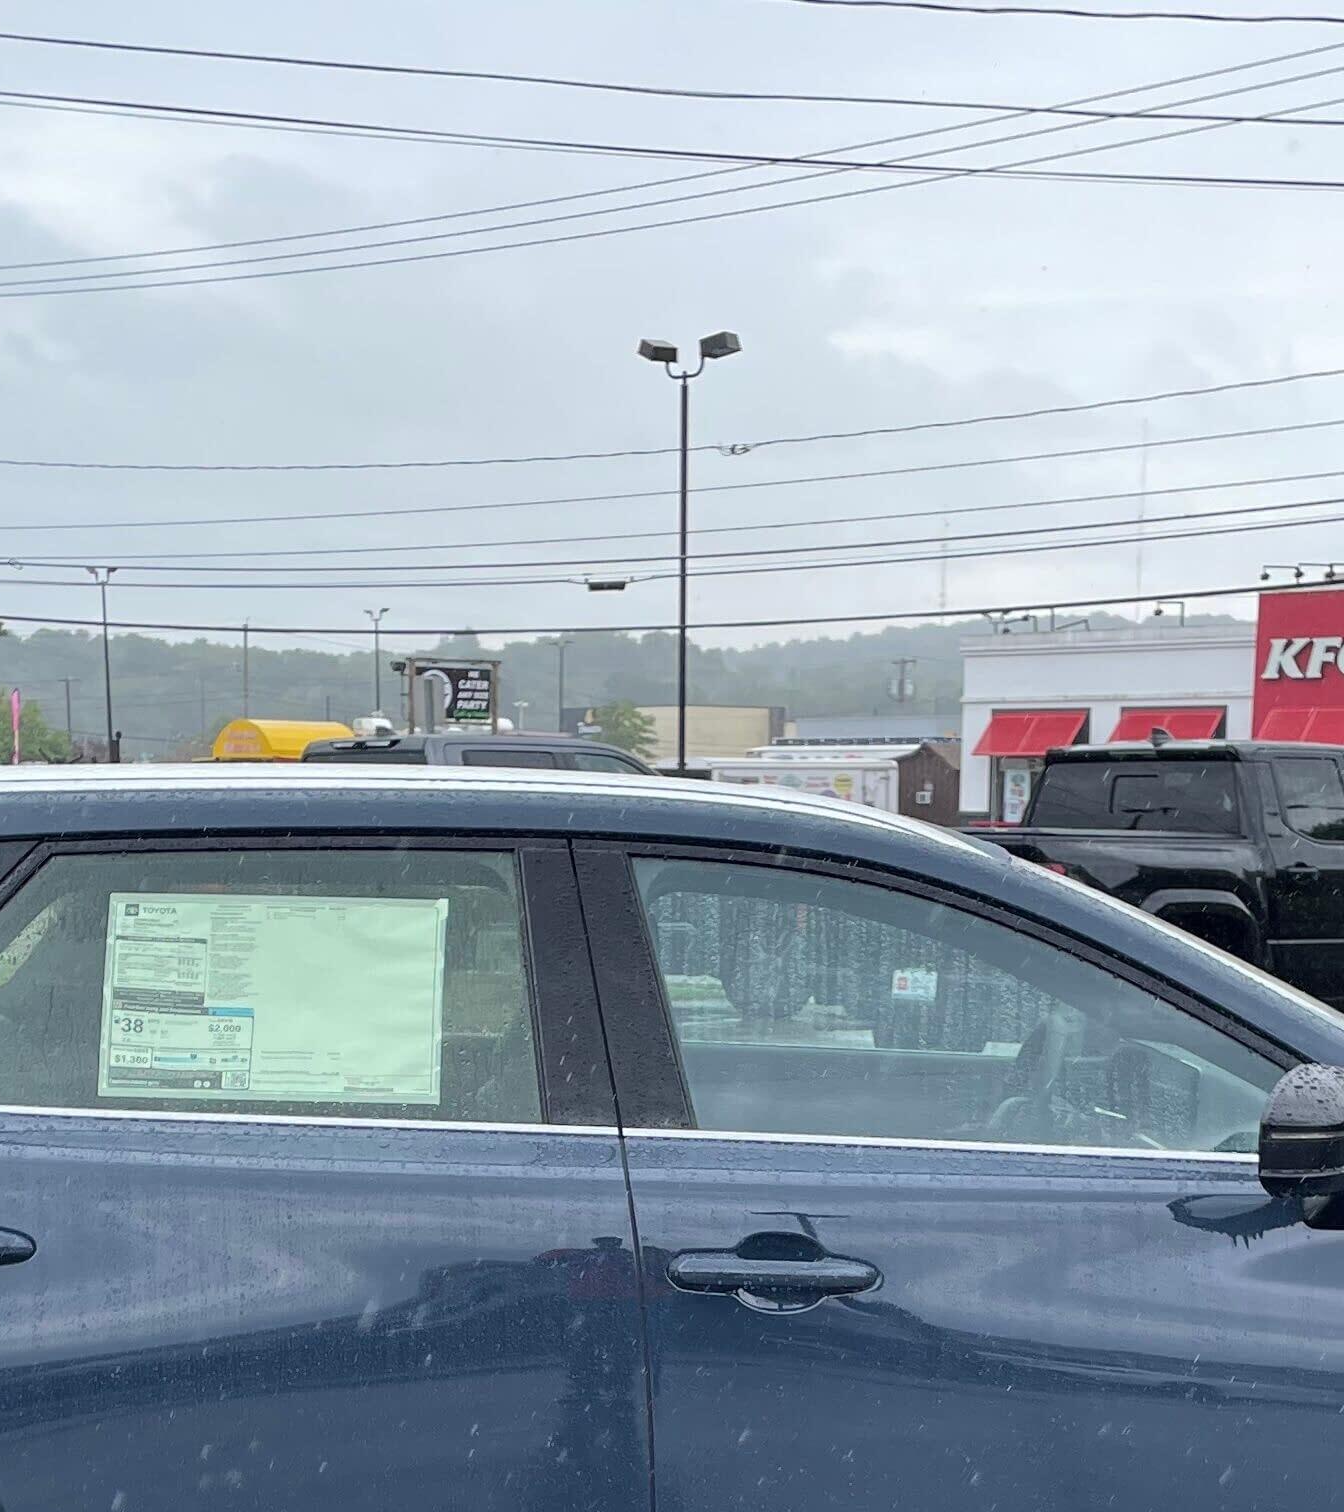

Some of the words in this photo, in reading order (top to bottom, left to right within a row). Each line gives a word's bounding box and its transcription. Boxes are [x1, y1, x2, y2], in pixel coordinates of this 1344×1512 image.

[458, 680, 489, 690] CATER
[457, 700, 488, 710] PARTY
[142, 907, 177, 915] TOYOTA
[121, 1017, 144, 1034] 38
[115, 1054, 149, 1064] $1,300
